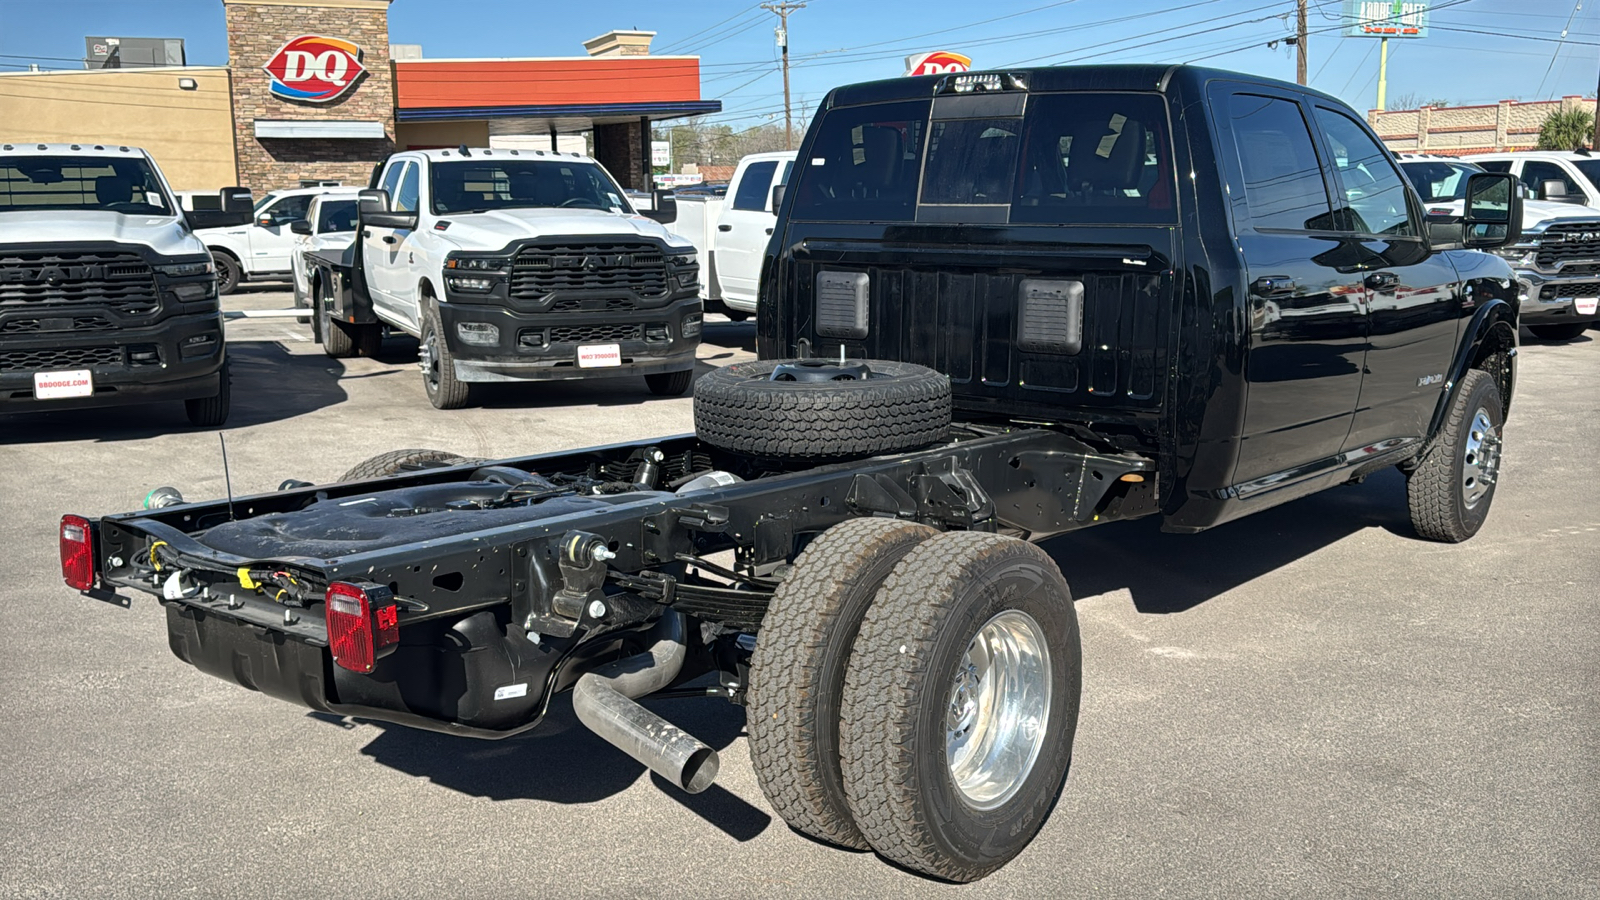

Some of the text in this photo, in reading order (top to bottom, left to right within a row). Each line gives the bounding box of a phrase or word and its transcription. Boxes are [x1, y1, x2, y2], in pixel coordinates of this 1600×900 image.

[1359, 2, 1392, 25] ADOBE
[283, 50, 348, 87] DQ
[553, 255, 630, 269] RAM
[0, 266, 104, 281] RAM
[39, 380, 88, 388] BBDODGE.COM
